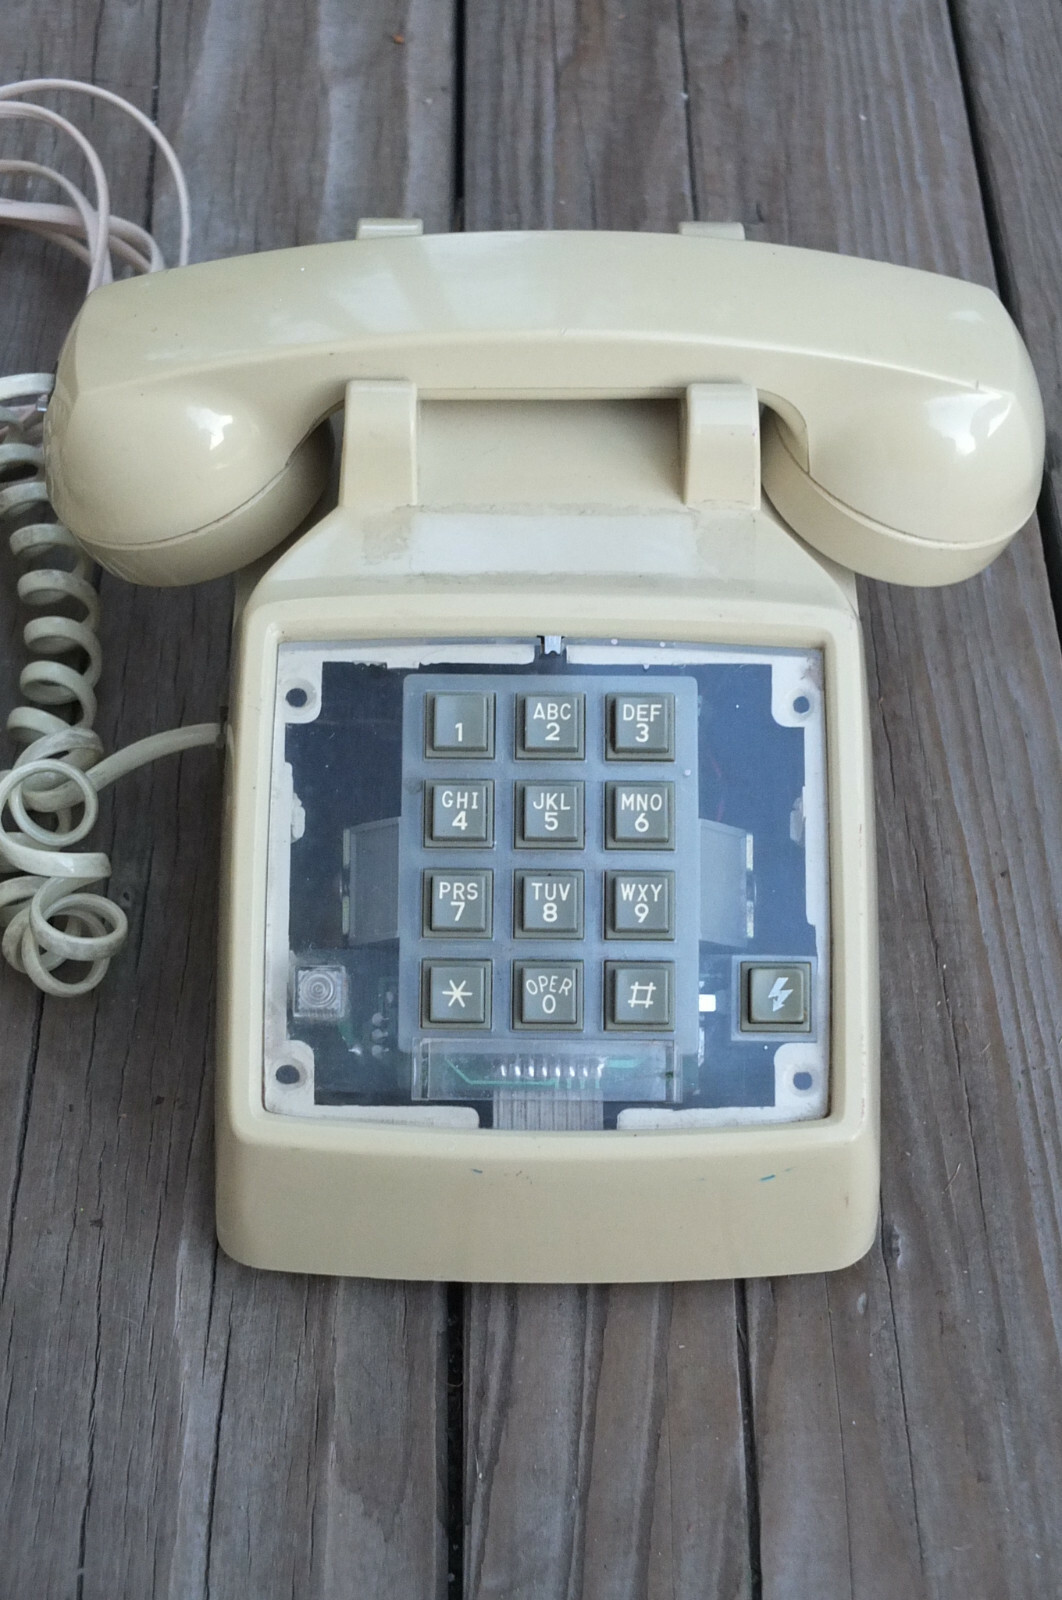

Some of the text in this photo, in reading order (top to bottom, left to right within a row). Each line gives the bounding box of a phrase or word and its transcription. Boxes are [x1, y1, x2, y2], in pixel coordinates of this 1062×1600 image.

[533, 703, 571, 720] ABC
[623, 704, 662, 722] DEF
[455, 723, 462, 741] 1
[545, 723, 560, 740] 2
[636, 724, 649, 742] 3
[442, 791, 478, 809] GHI
[533, 794, 570, 811] JKL
[621, 794, 662, 811] MNO
[452, 812, 467, 830] 4
[545, 813, 558, 830] 5
[635, 814, 649, 832] 6
[439, 882, 478, 900] PRS
[532, 883, 570, 900] TUV
[621, 884, 662, 901] WXY
[451, 902, 465, 921] 7
[543, 903, 557, 921] 8
[635, 904, 649, 922] 9
[526, 976, 572, 996] OPER
